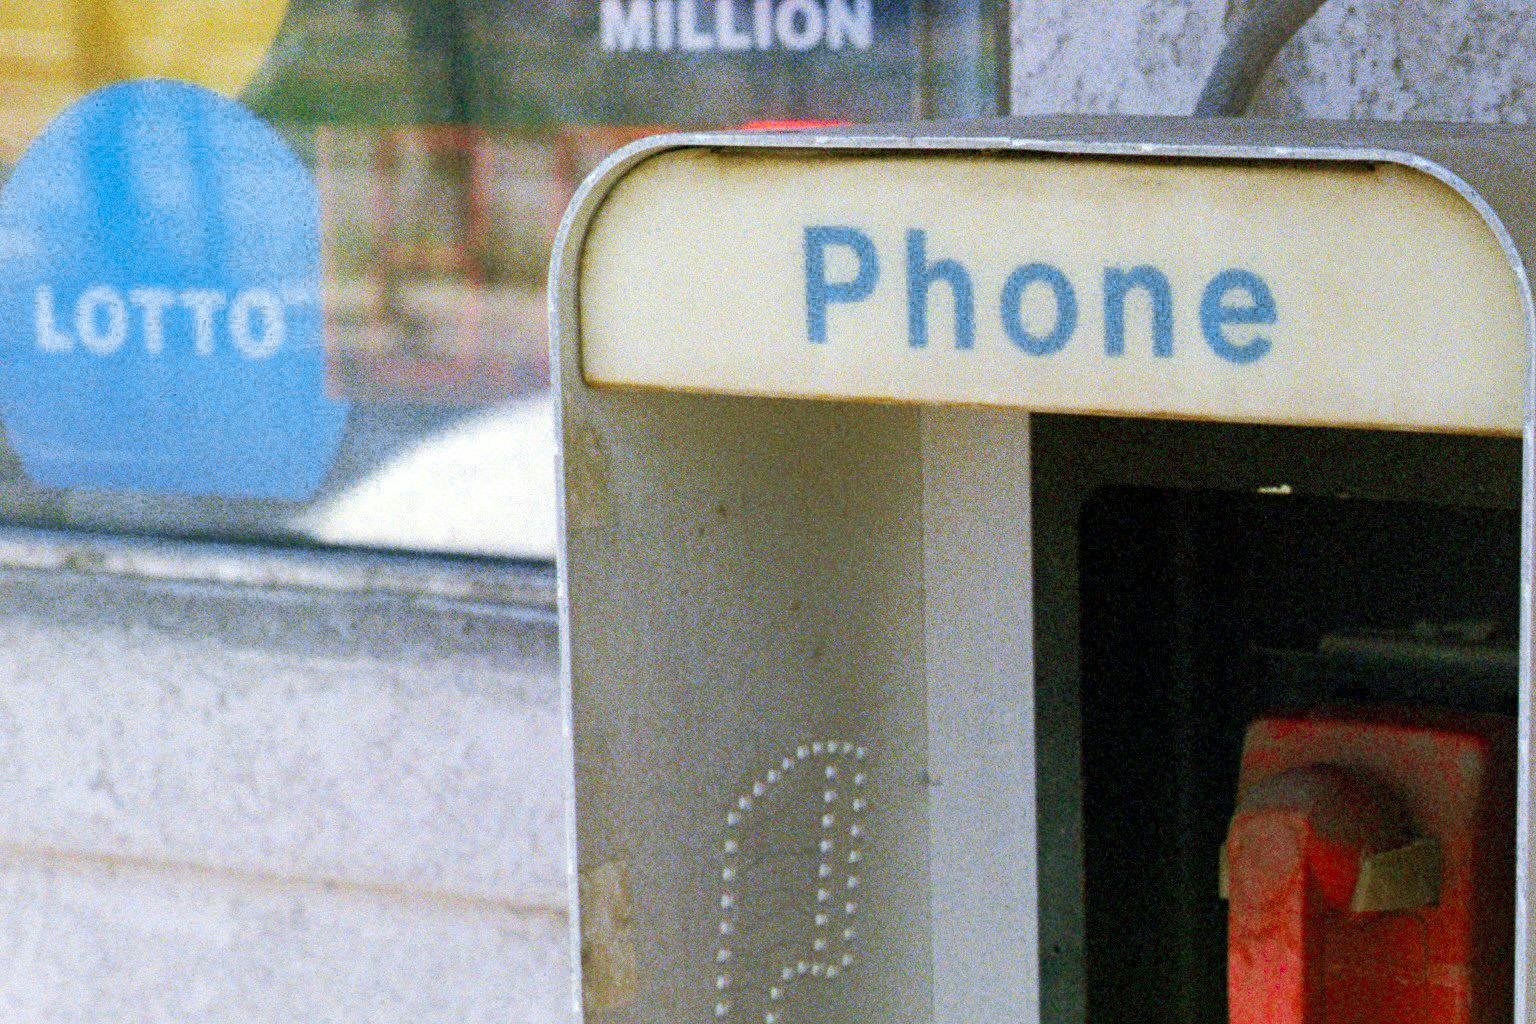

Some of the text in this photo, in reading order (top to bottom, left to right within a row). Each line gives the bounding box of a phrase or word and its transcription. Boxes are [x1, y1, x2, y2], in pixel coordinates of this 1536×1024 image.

[600, 0, 874, 52] MILLION
[34, 283, 286, 358] LOTTO
[804, 224, 1277, 364] Phone
